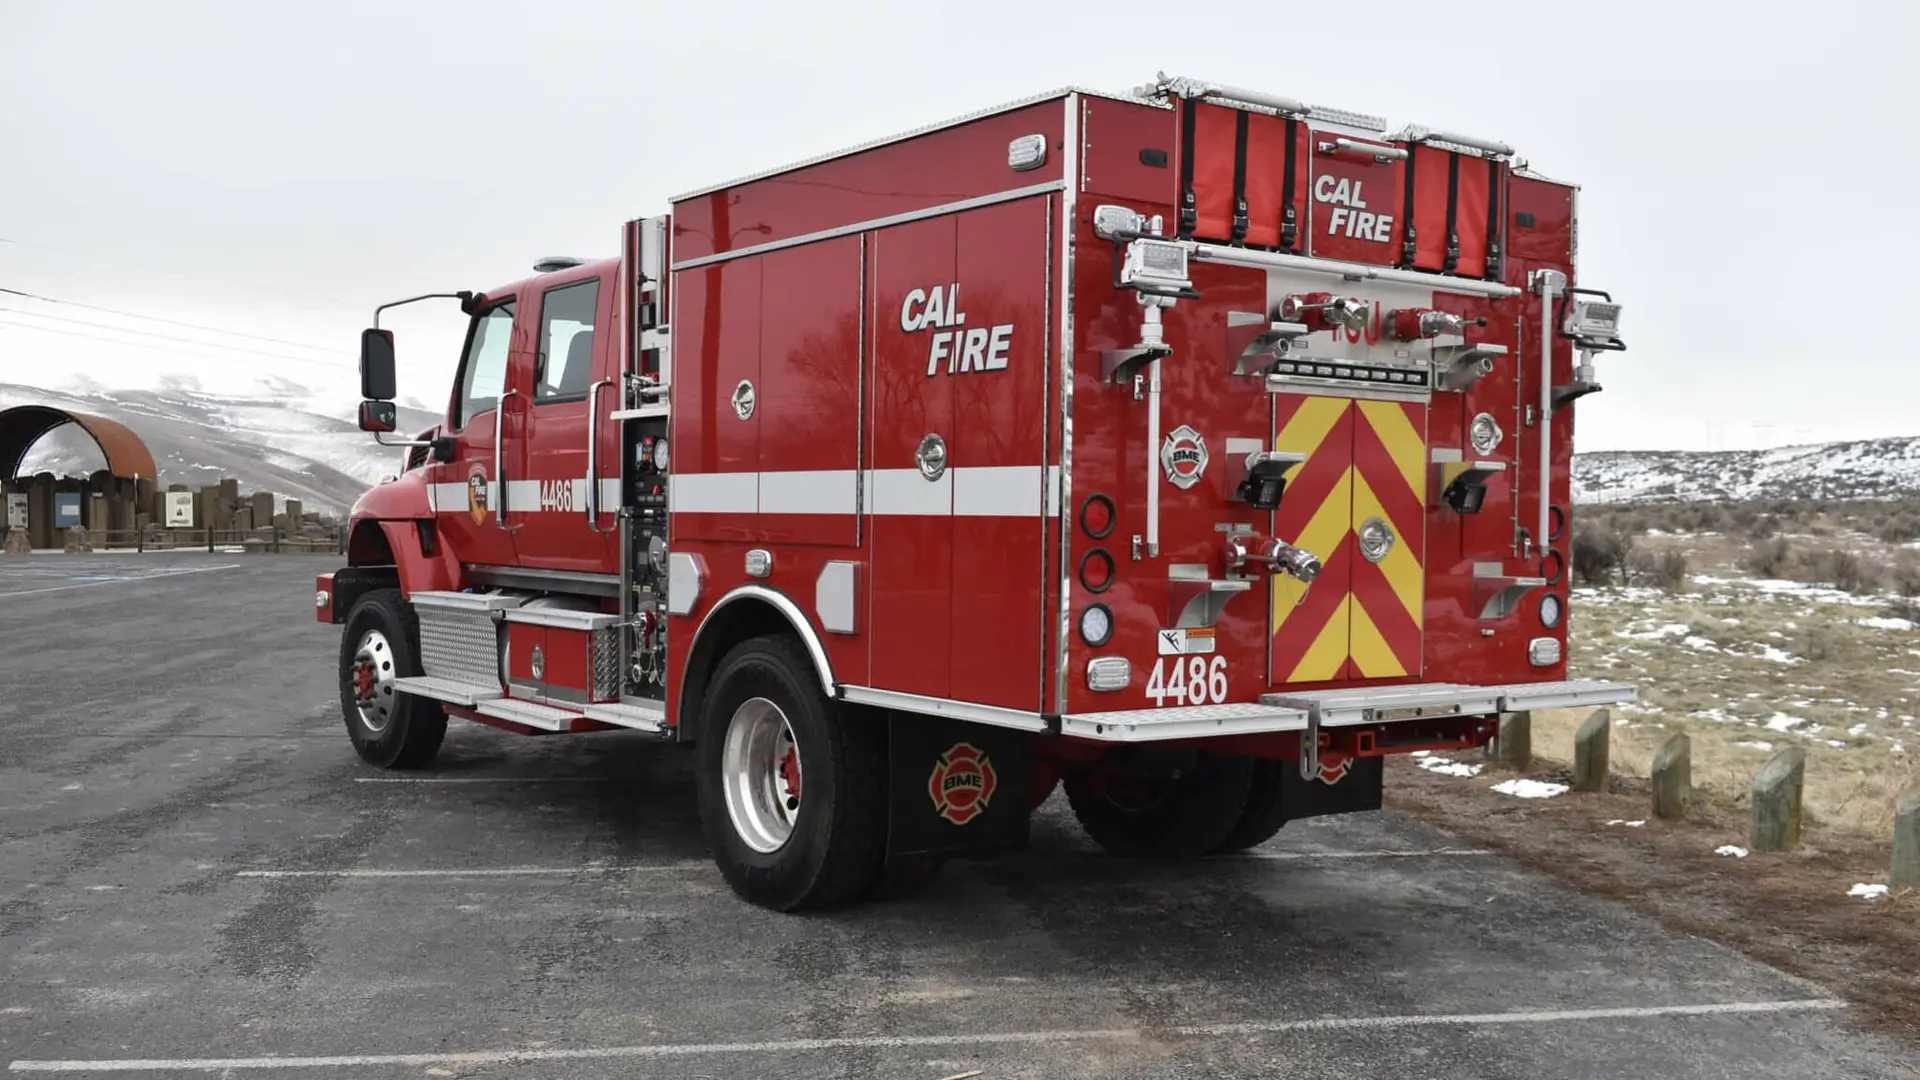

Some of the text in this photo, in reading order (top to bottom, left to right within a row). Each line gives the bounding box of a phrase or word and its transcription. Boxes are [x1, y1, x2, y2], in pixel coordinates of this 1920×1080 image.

[1314, 174, 1367, 209] CAL
[1328, 207, 1394, 243] FIRE
[901, 282, 966, 332] CAL
[927, 324, 1014, 376] FIRE
[1173, 450, 1200, 462] BME
[541, 479, 572, 512] 4486
[1145, 655, 1228, 707] 4486
[944, 774, 982, 790] BME
